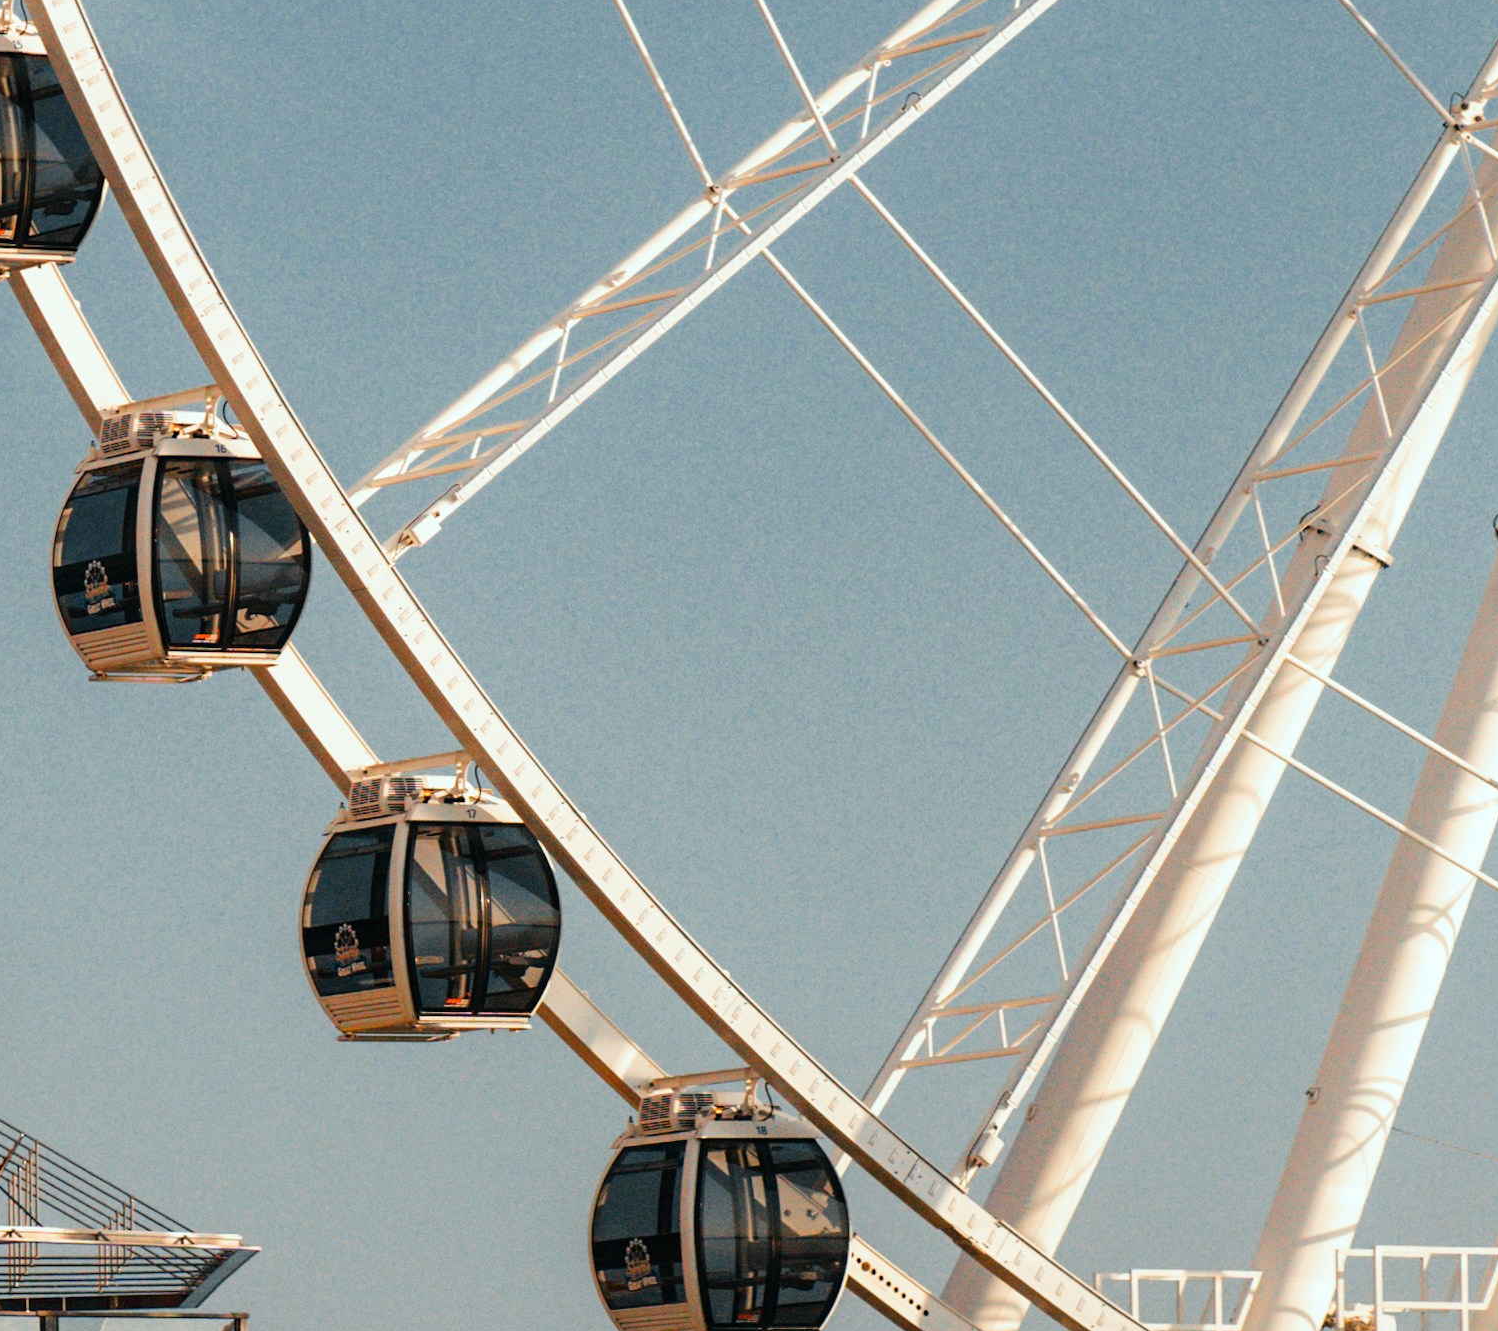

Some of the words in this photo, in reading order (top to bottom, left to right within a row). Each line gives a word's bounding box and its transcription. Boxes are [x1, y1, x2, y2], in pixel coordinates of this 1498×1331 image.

[215, 444, 227, 454] 16
[466, 809, 477, 819] 17
[756, 1125, 768, 1136] 18
